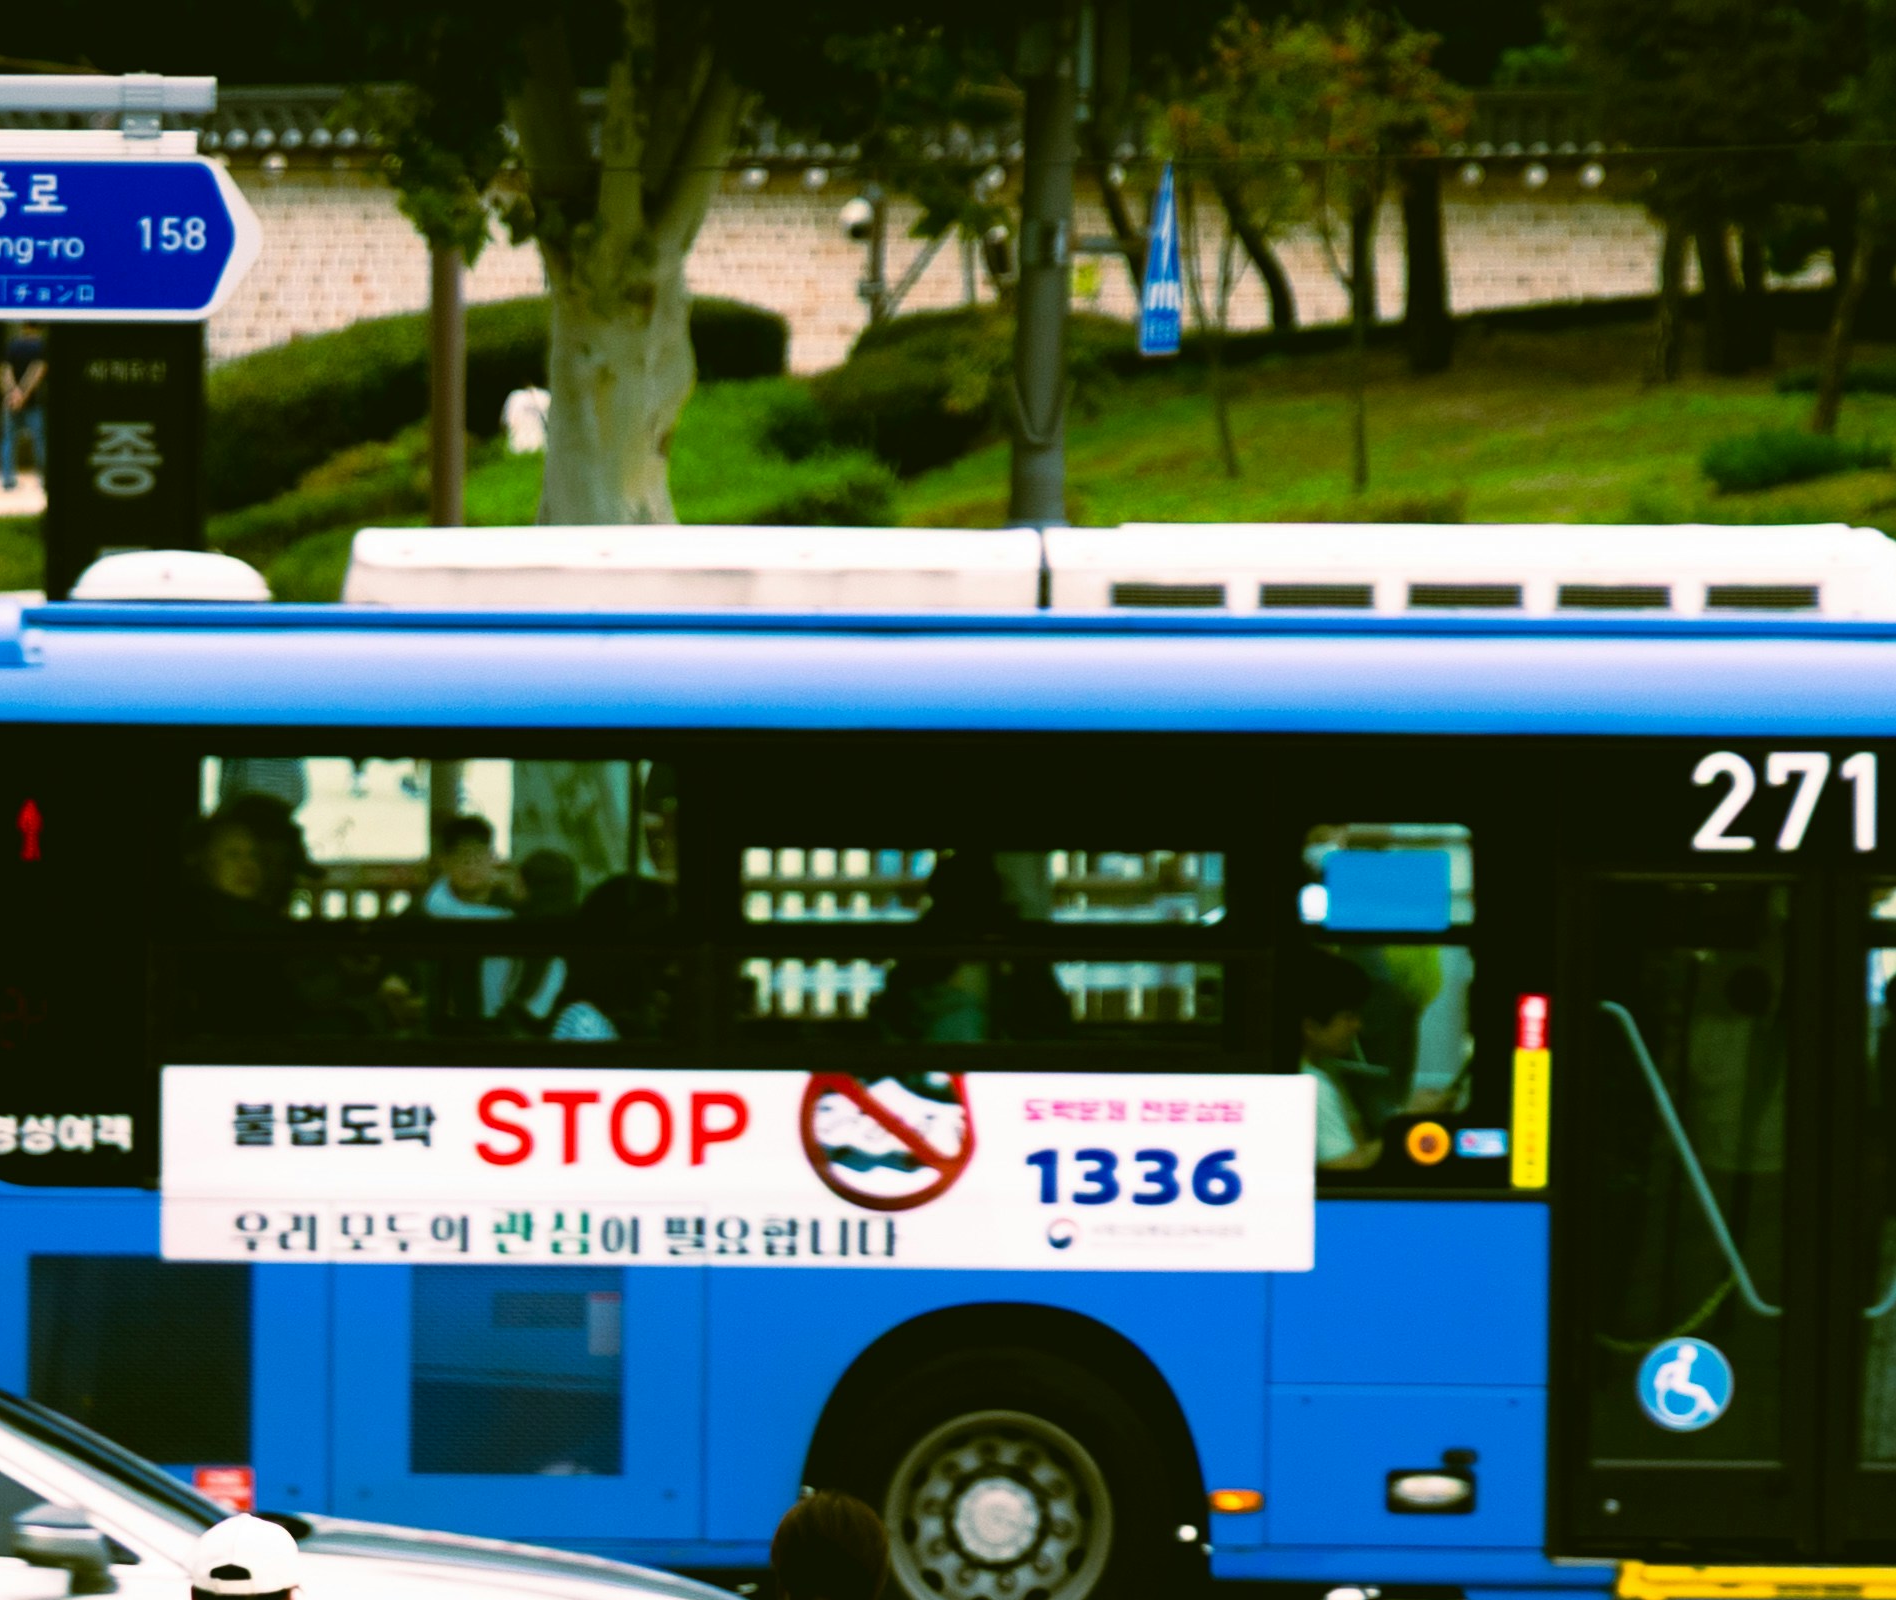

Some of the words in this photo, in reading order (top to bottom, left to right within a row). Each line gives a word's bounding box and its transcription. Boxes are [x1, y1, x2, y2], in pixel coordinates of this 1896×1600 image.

[139, 216, 208, 253] 158
[1692, 752, 1878, 852] 271
[233, 1103, 438, 1149] 불법도박
[475, 1088, 750, 1168] STOP
[1025, 1148, 1243, 1207] 1336
[233, 1215, 318, 1253] 우리
[340, 1215, 471, 1255] 모두의
[492, 1211, 641, 1257] 관심이
[663, 1216, 899, 1259] 필요합니다
